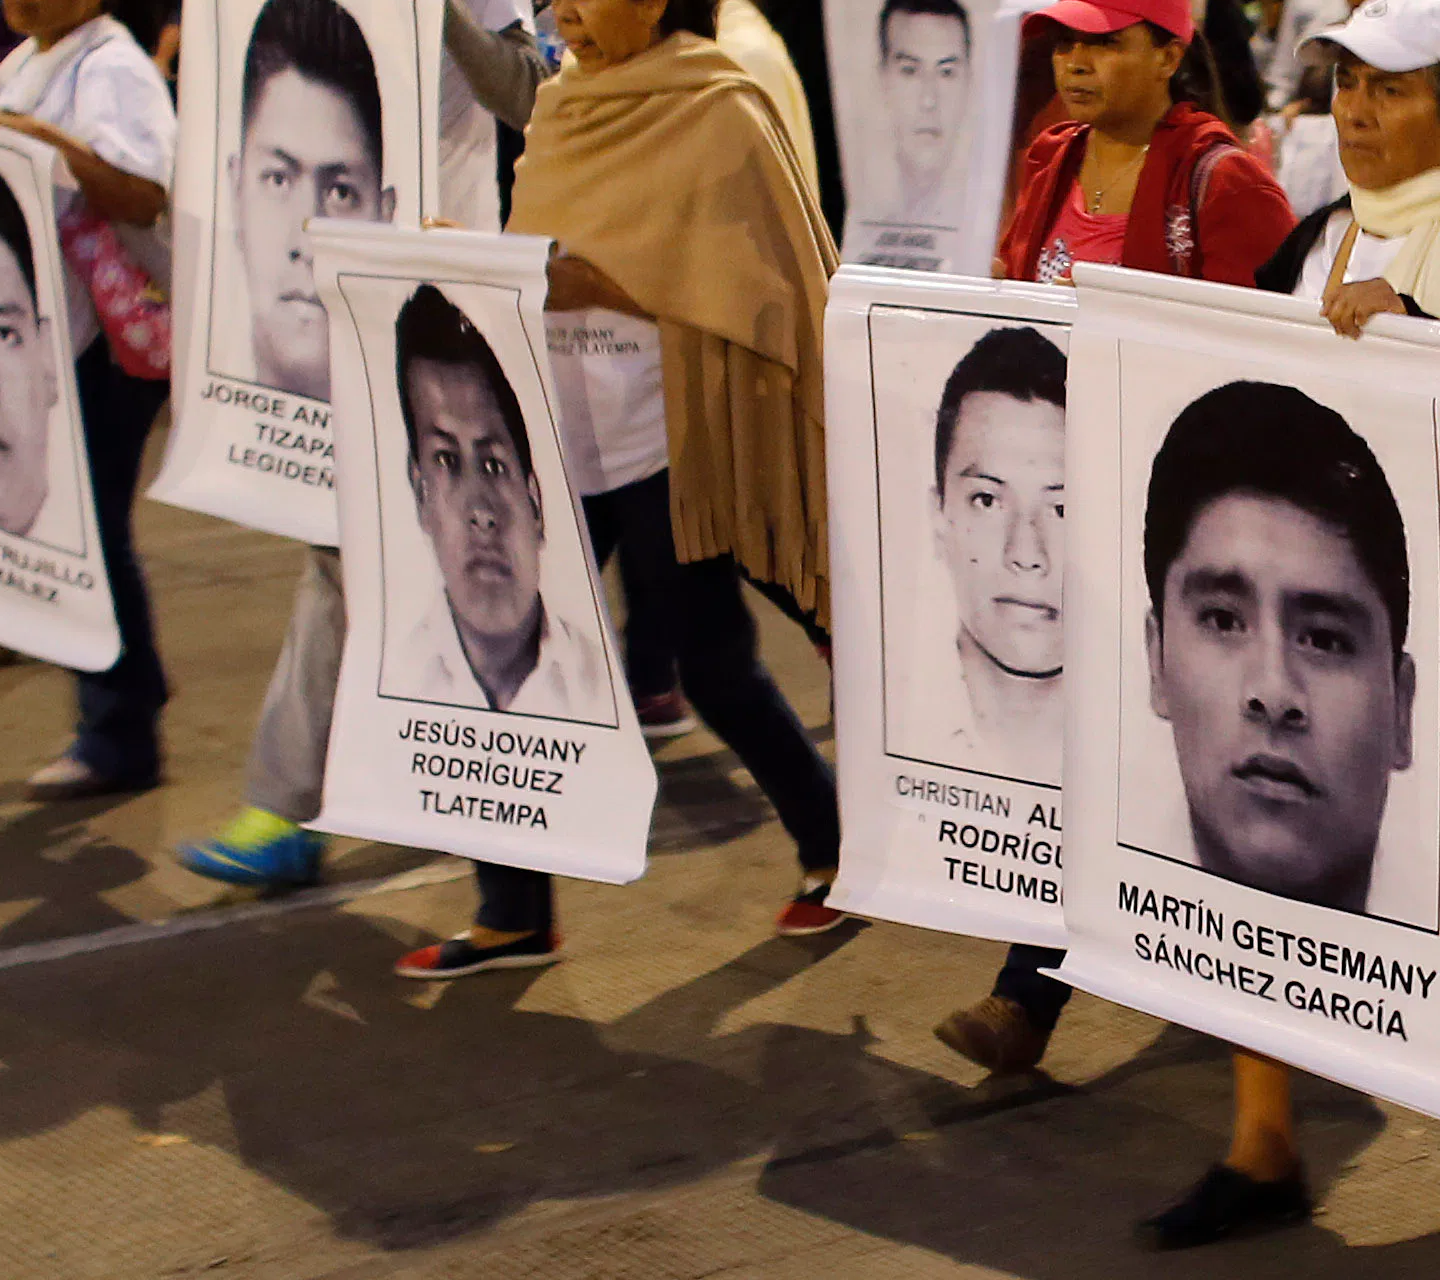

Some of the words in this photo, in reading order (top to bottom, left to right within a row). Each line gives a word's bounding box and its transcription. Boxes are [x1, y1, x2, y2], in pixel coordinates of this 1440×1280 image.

[201, 382, 287, 419] JORGE
[399, 719, 476, 748] JESÚS
[481, 730, 587, 764] JOVANY
[412, 753, 564, 794] RODRÍGUEZ
[420, 790, 548, 829] TLATEMPA
[896, 775, 1011, 818] CHRISTIAN
[1118, 881, 1224, 942] MARTÍN
[1232, 920, 1437, 999] GETSEMANY
[1134, 934, 1278, 1003] SÁNCHEZ
[1284, 980, 1409, 1042] GARCÍA
